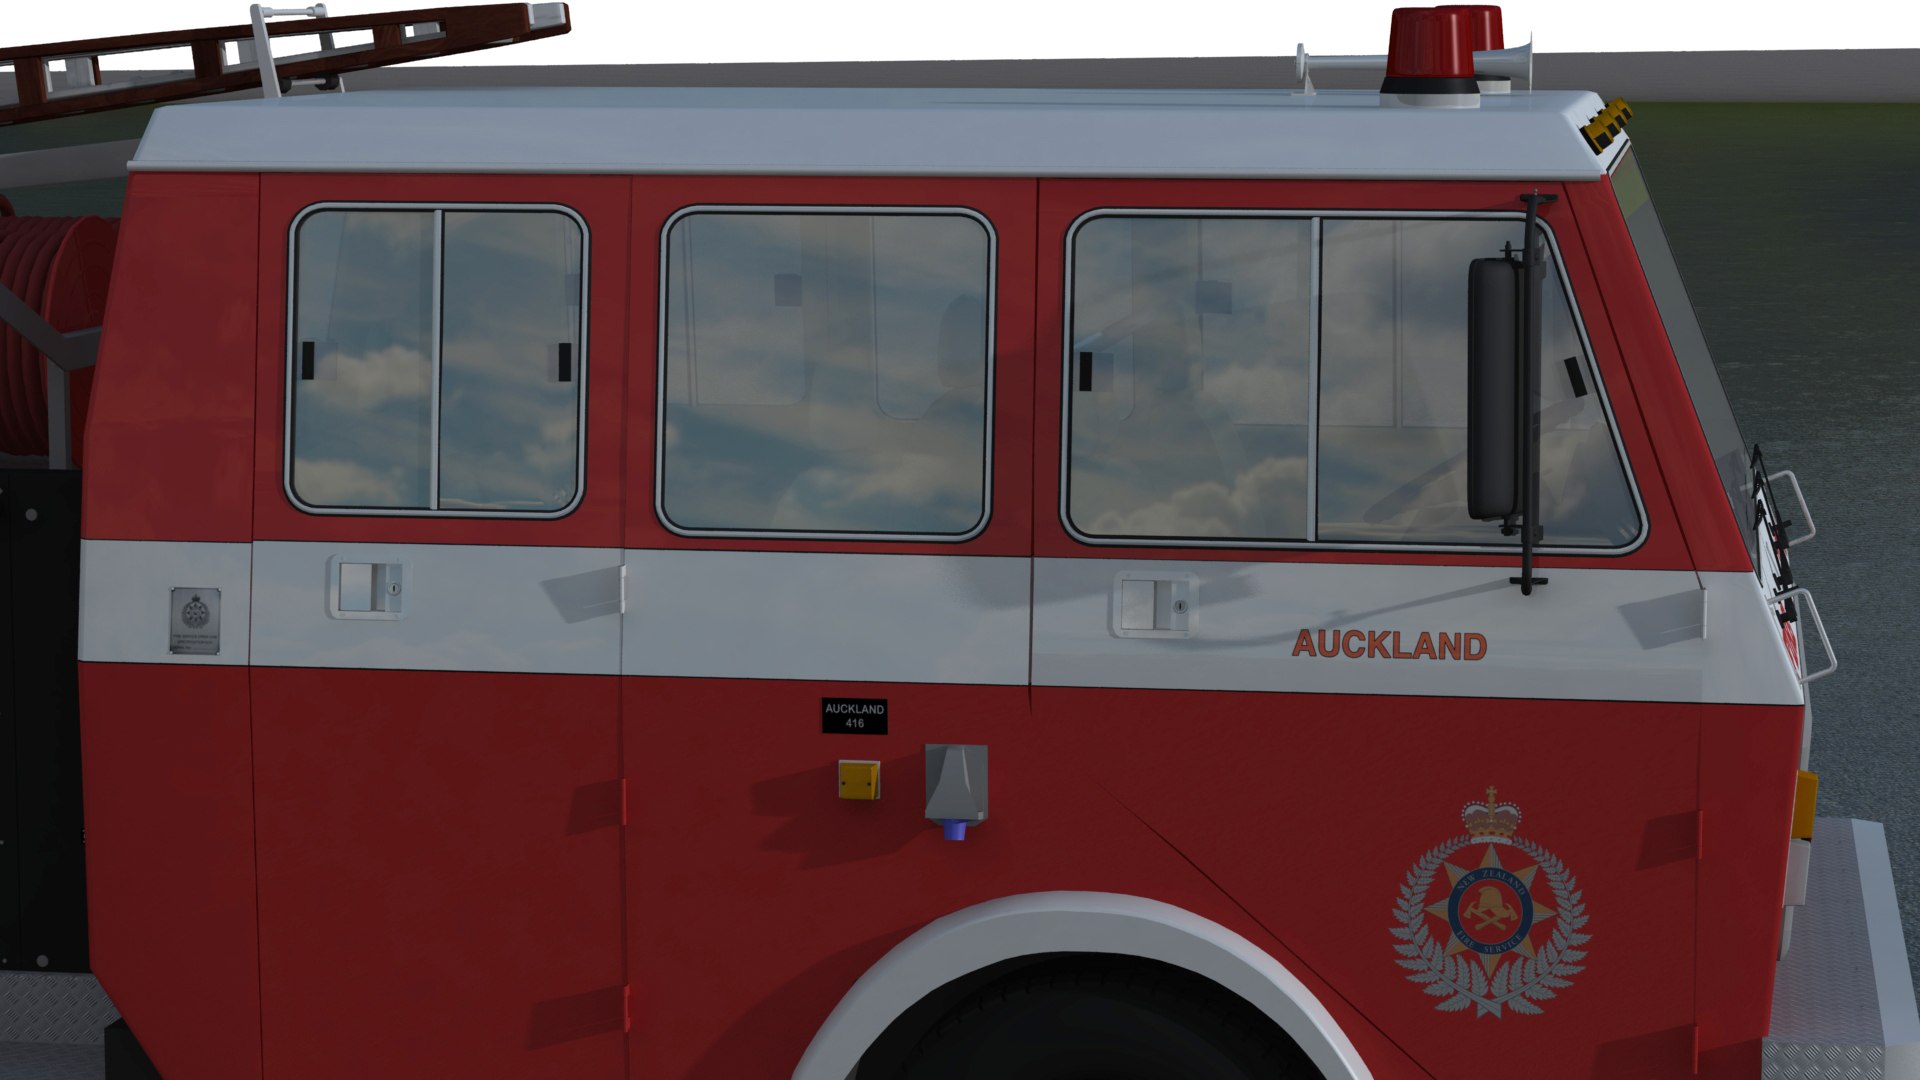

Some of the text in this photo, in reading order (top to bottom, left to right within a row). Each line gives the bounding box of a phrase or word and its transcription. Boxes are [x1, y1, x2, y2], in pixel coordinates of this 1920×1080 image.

[1291, 628, 1488, 661] AUCKLAND
[825, 703, 885, 715] AUCKLAND
[845, 718, 865, 728] 416
[1457, 869, 1526, 896] NEW ZEALAND
[1456, 929, 1522, 953] FIRE SERVICE
